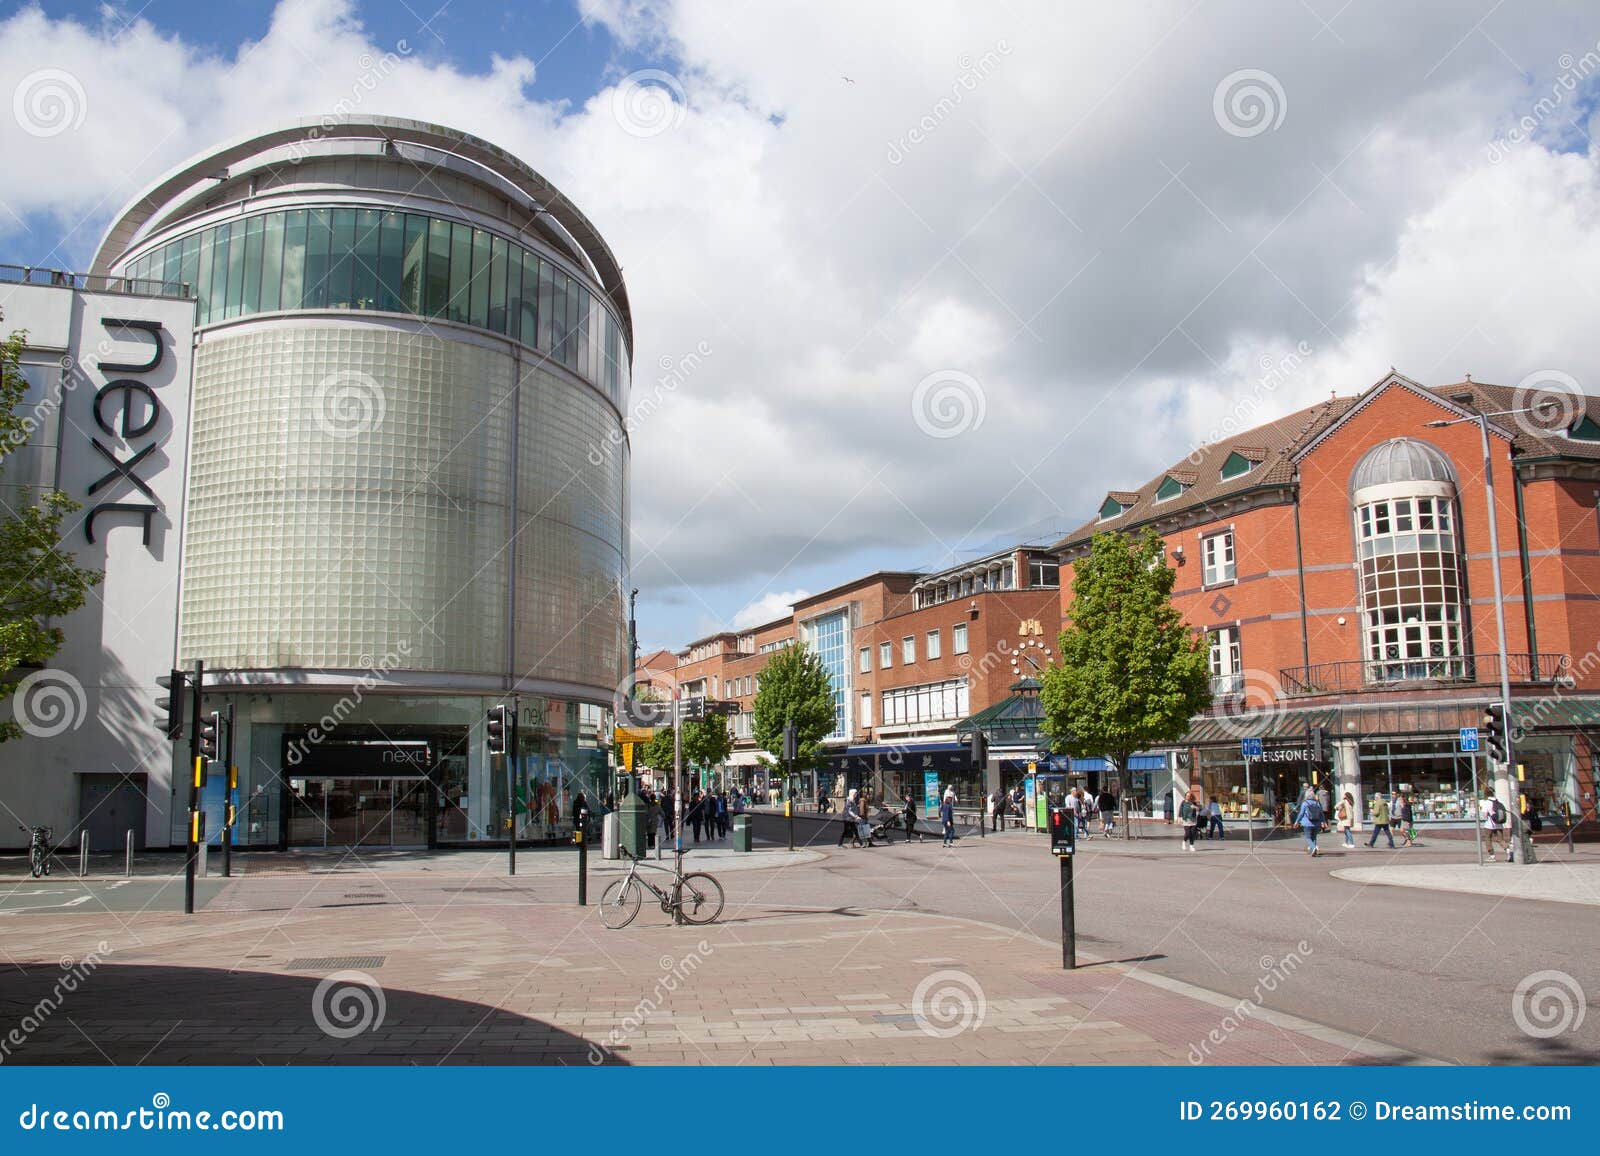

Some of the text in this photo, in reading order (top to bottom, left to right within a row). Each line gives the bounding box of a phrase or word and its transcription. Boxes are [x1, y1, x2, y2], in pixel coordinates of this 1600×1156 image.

[85, 317, 163, 545] next
[383, 750, 424, 762] next
[1180, 754, 1188, 762] W
